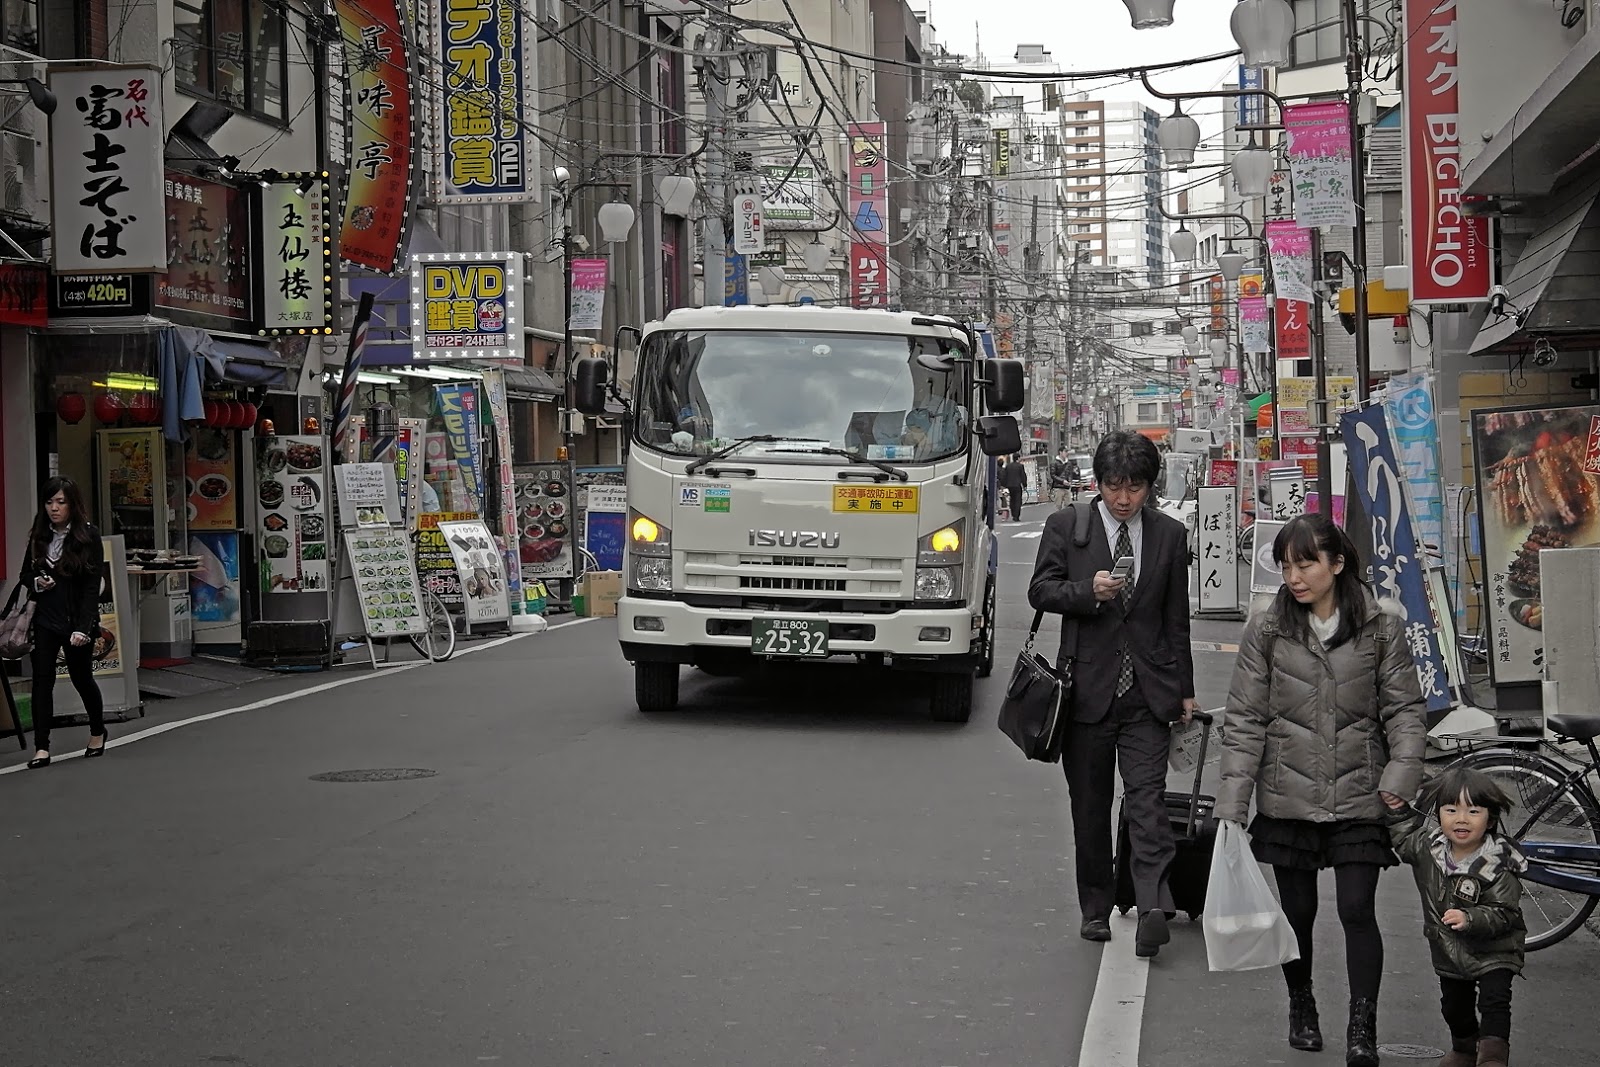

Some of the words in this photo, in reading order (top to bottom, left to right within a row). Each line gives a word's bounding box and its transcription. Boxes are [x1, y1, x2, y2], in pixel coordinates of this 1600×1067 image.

[124, 79, 150, 128] 名代
[75, 84, 138, 260] 富士そば
[501, 143, 519, 184] 2F
[743, 212, 753, 239] マルヨ
[1430, 189, 1465, 287] ECHO
[277, 202, 314, 301] 玉仙楼
[87, 283, 127, 301] 420円
[426, 266, 505, 299] DVD
[277, 311, 313, 321] 大塚店
[426, 300, 477, 331] 鑑賞
[426, 336, 462, 347] 受付2F
[682, 488, 699, 500] MS
[838, 488, 913, 499] 交通事故防止運動
[848, 499, 903, 509] 実施中
[748, 529, 840, 549] ISUZU
[1203, 510, 1223, 589] ぼたん
[764, 629, 825, 653] 25-32
